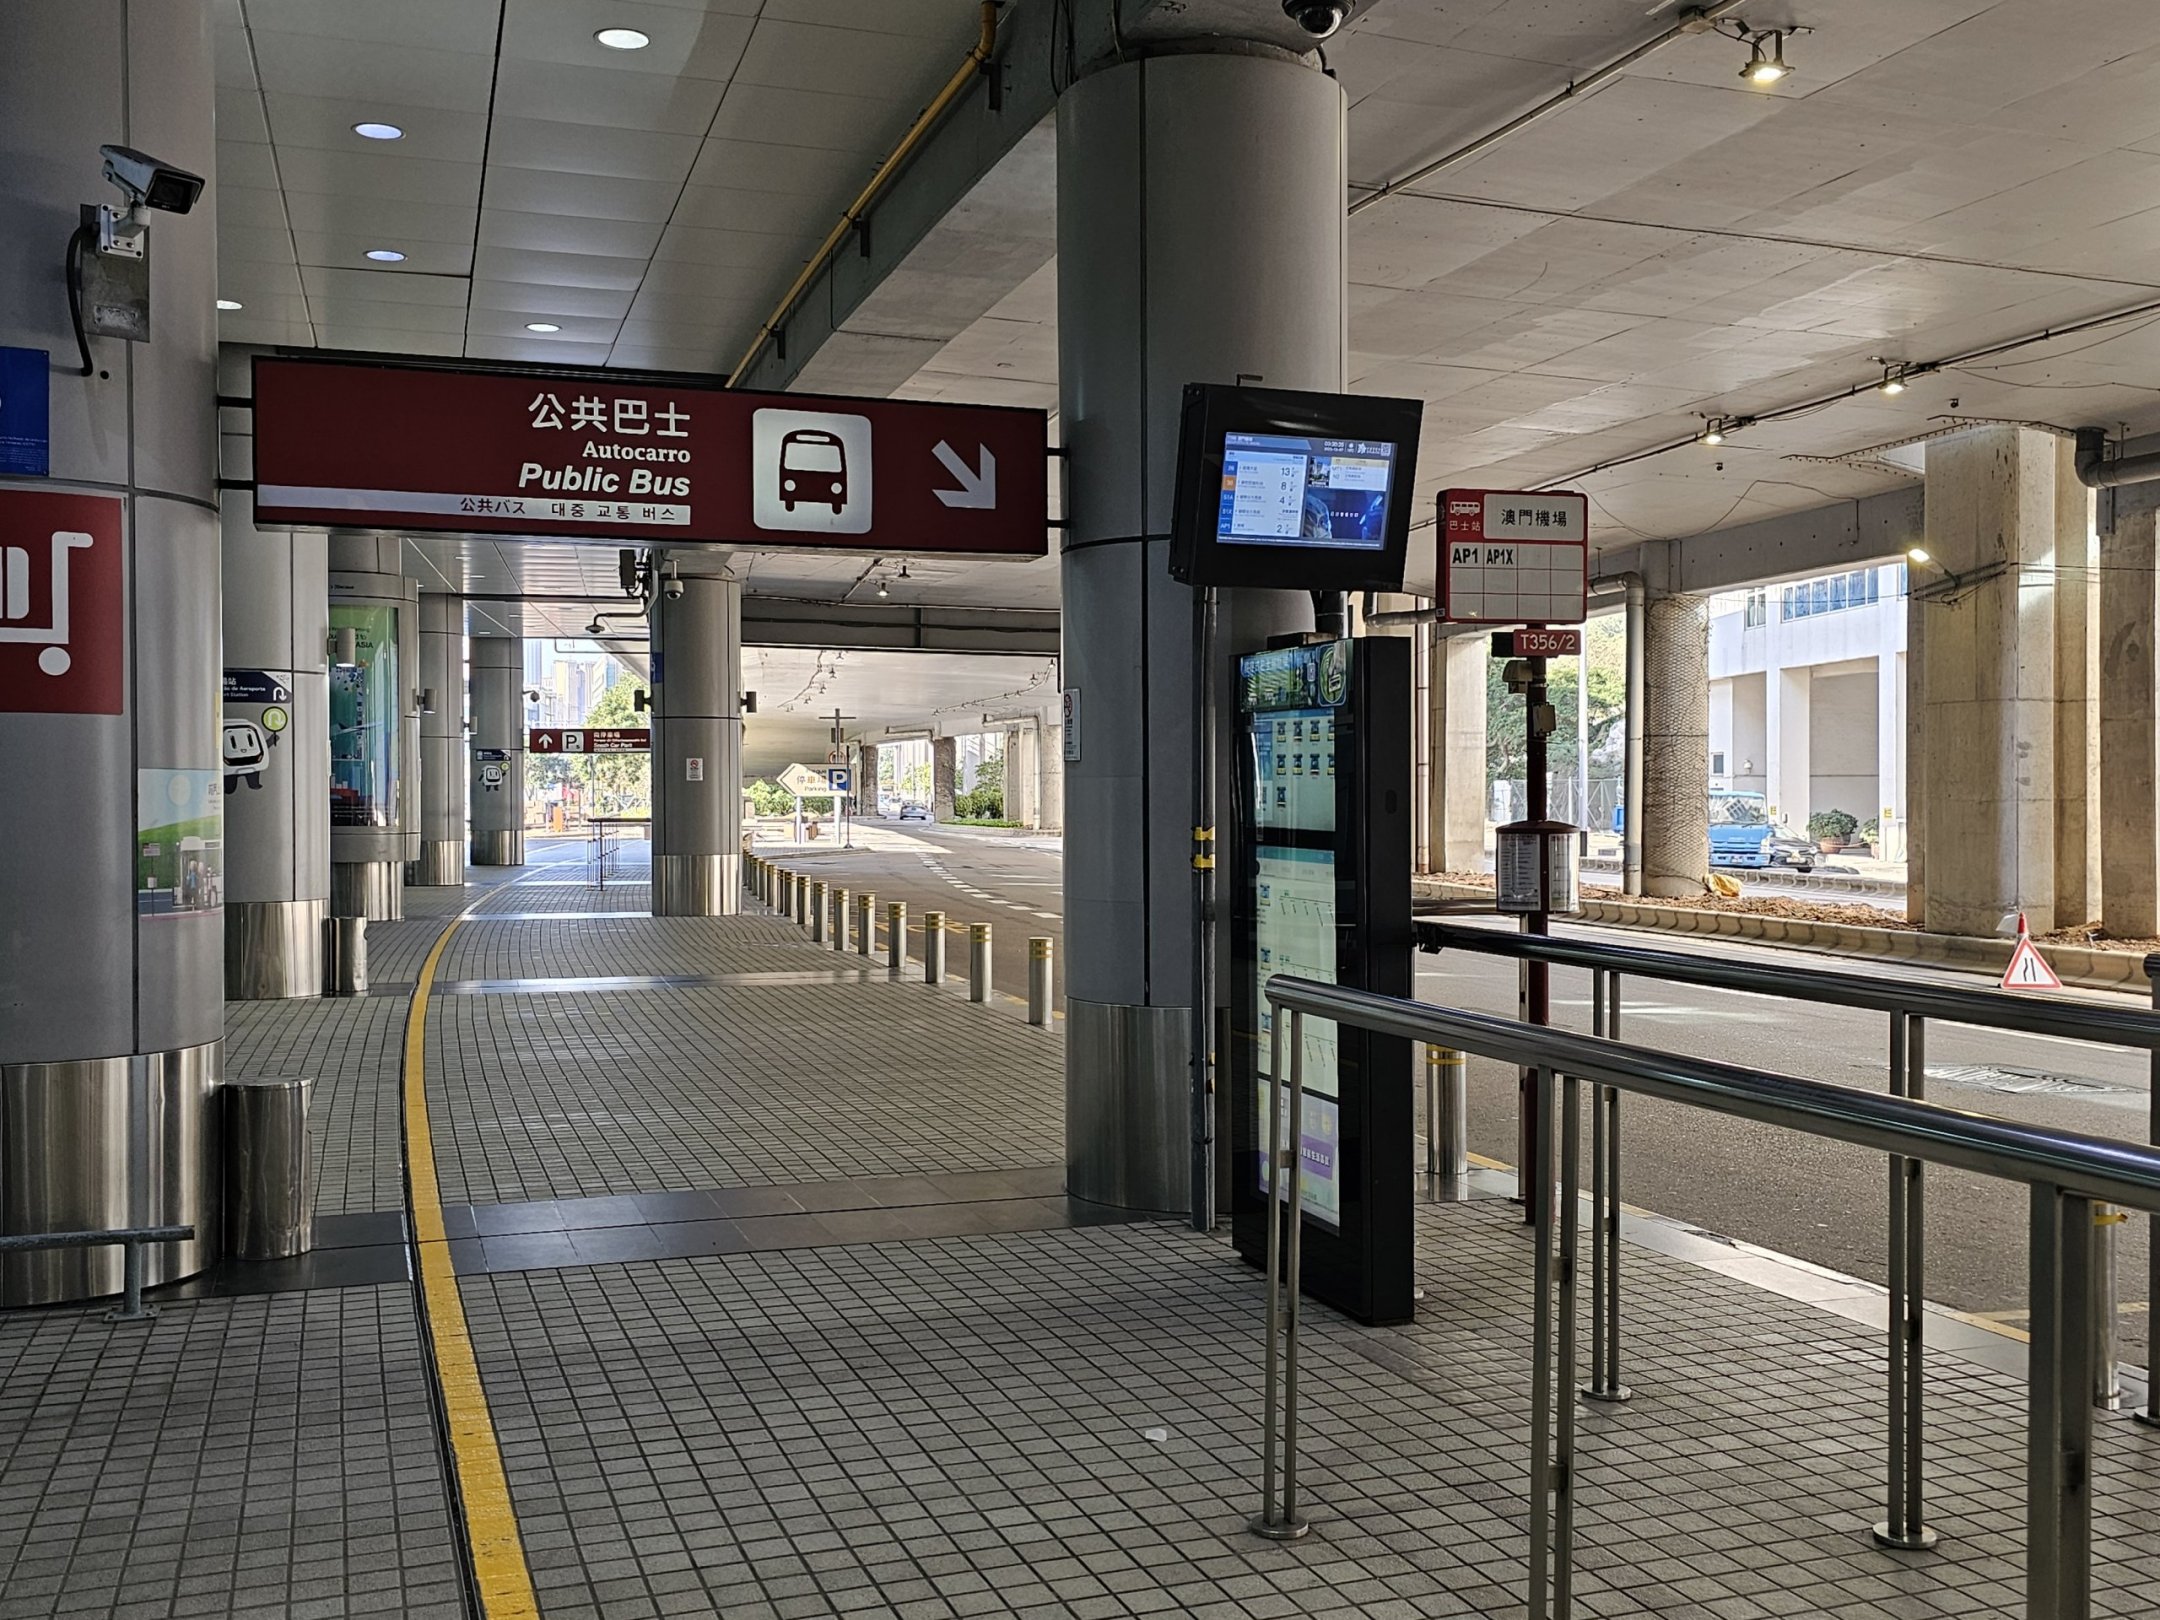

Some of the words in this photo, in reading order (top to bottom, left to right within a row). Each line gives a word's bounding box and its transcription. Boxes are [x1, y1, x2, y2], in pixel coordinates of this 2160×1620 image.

[528, 393, 691, 437] 公共巴士
[582, 441, 691, 463] Autocarro
[518, 463, 620, 493] Public
[628, 469, 691, 496] Bus
[1281, 467, 1291, 476] 13
[1281, 482, 1287, 490] 8
[460, 497, 526, 515] 公共バス
[551, 502, 585, 518] 대중
[596, 504, 631, 520] 교통
[642, 507, 676, 521] 버스
[1449, 520, 1481, 532] 巴士站
[1501, 508, 1567, 527] 澳門機場
[1277, 524, 1283, 533] 2
[1452, 548, 1479, 564] AP1
[1486, 549, 1514, 565] AP1X
[1520, 634, 1576, 650] T356/2
[832, 770, 848, 789] P
